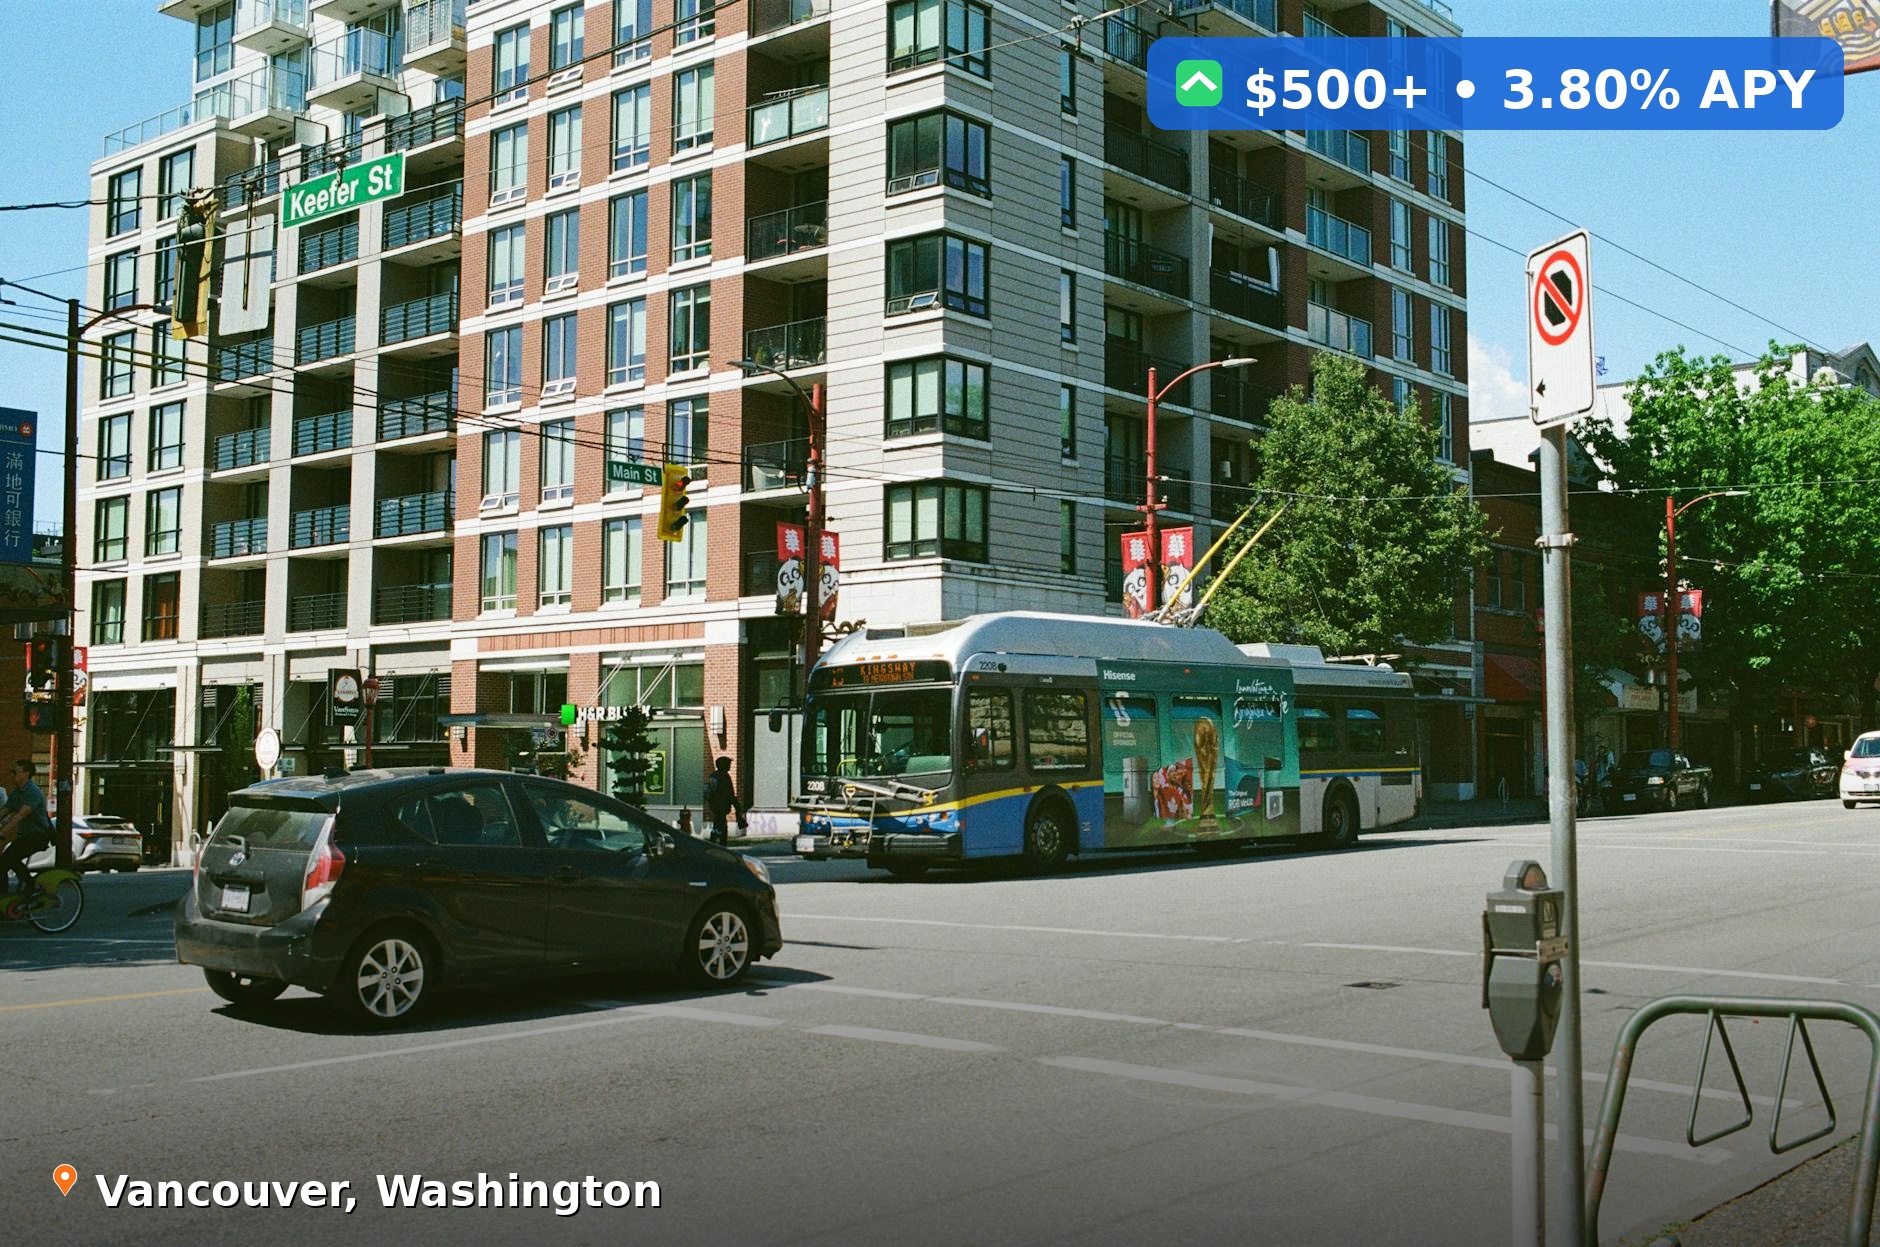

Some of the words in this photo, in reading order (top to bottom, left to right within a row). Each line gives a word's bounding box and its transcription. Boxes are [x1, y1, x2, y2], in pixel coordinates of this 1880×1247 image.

[290, 177, 359, 220] Keefer
[367, 164, 393, 196] St
[612, 464, 640, 480] Main
[644, 468, 657, 483] St
[4, 450, 23, 548] 滿地可銀行
[979, 661, 997, 671] 2208
[1103, 669, 1136, 681] Hisense
[577, 706, 606, 721] H&R
[607, 705, 651, 721] BLK
[807, 780, 825, 791] 2208
